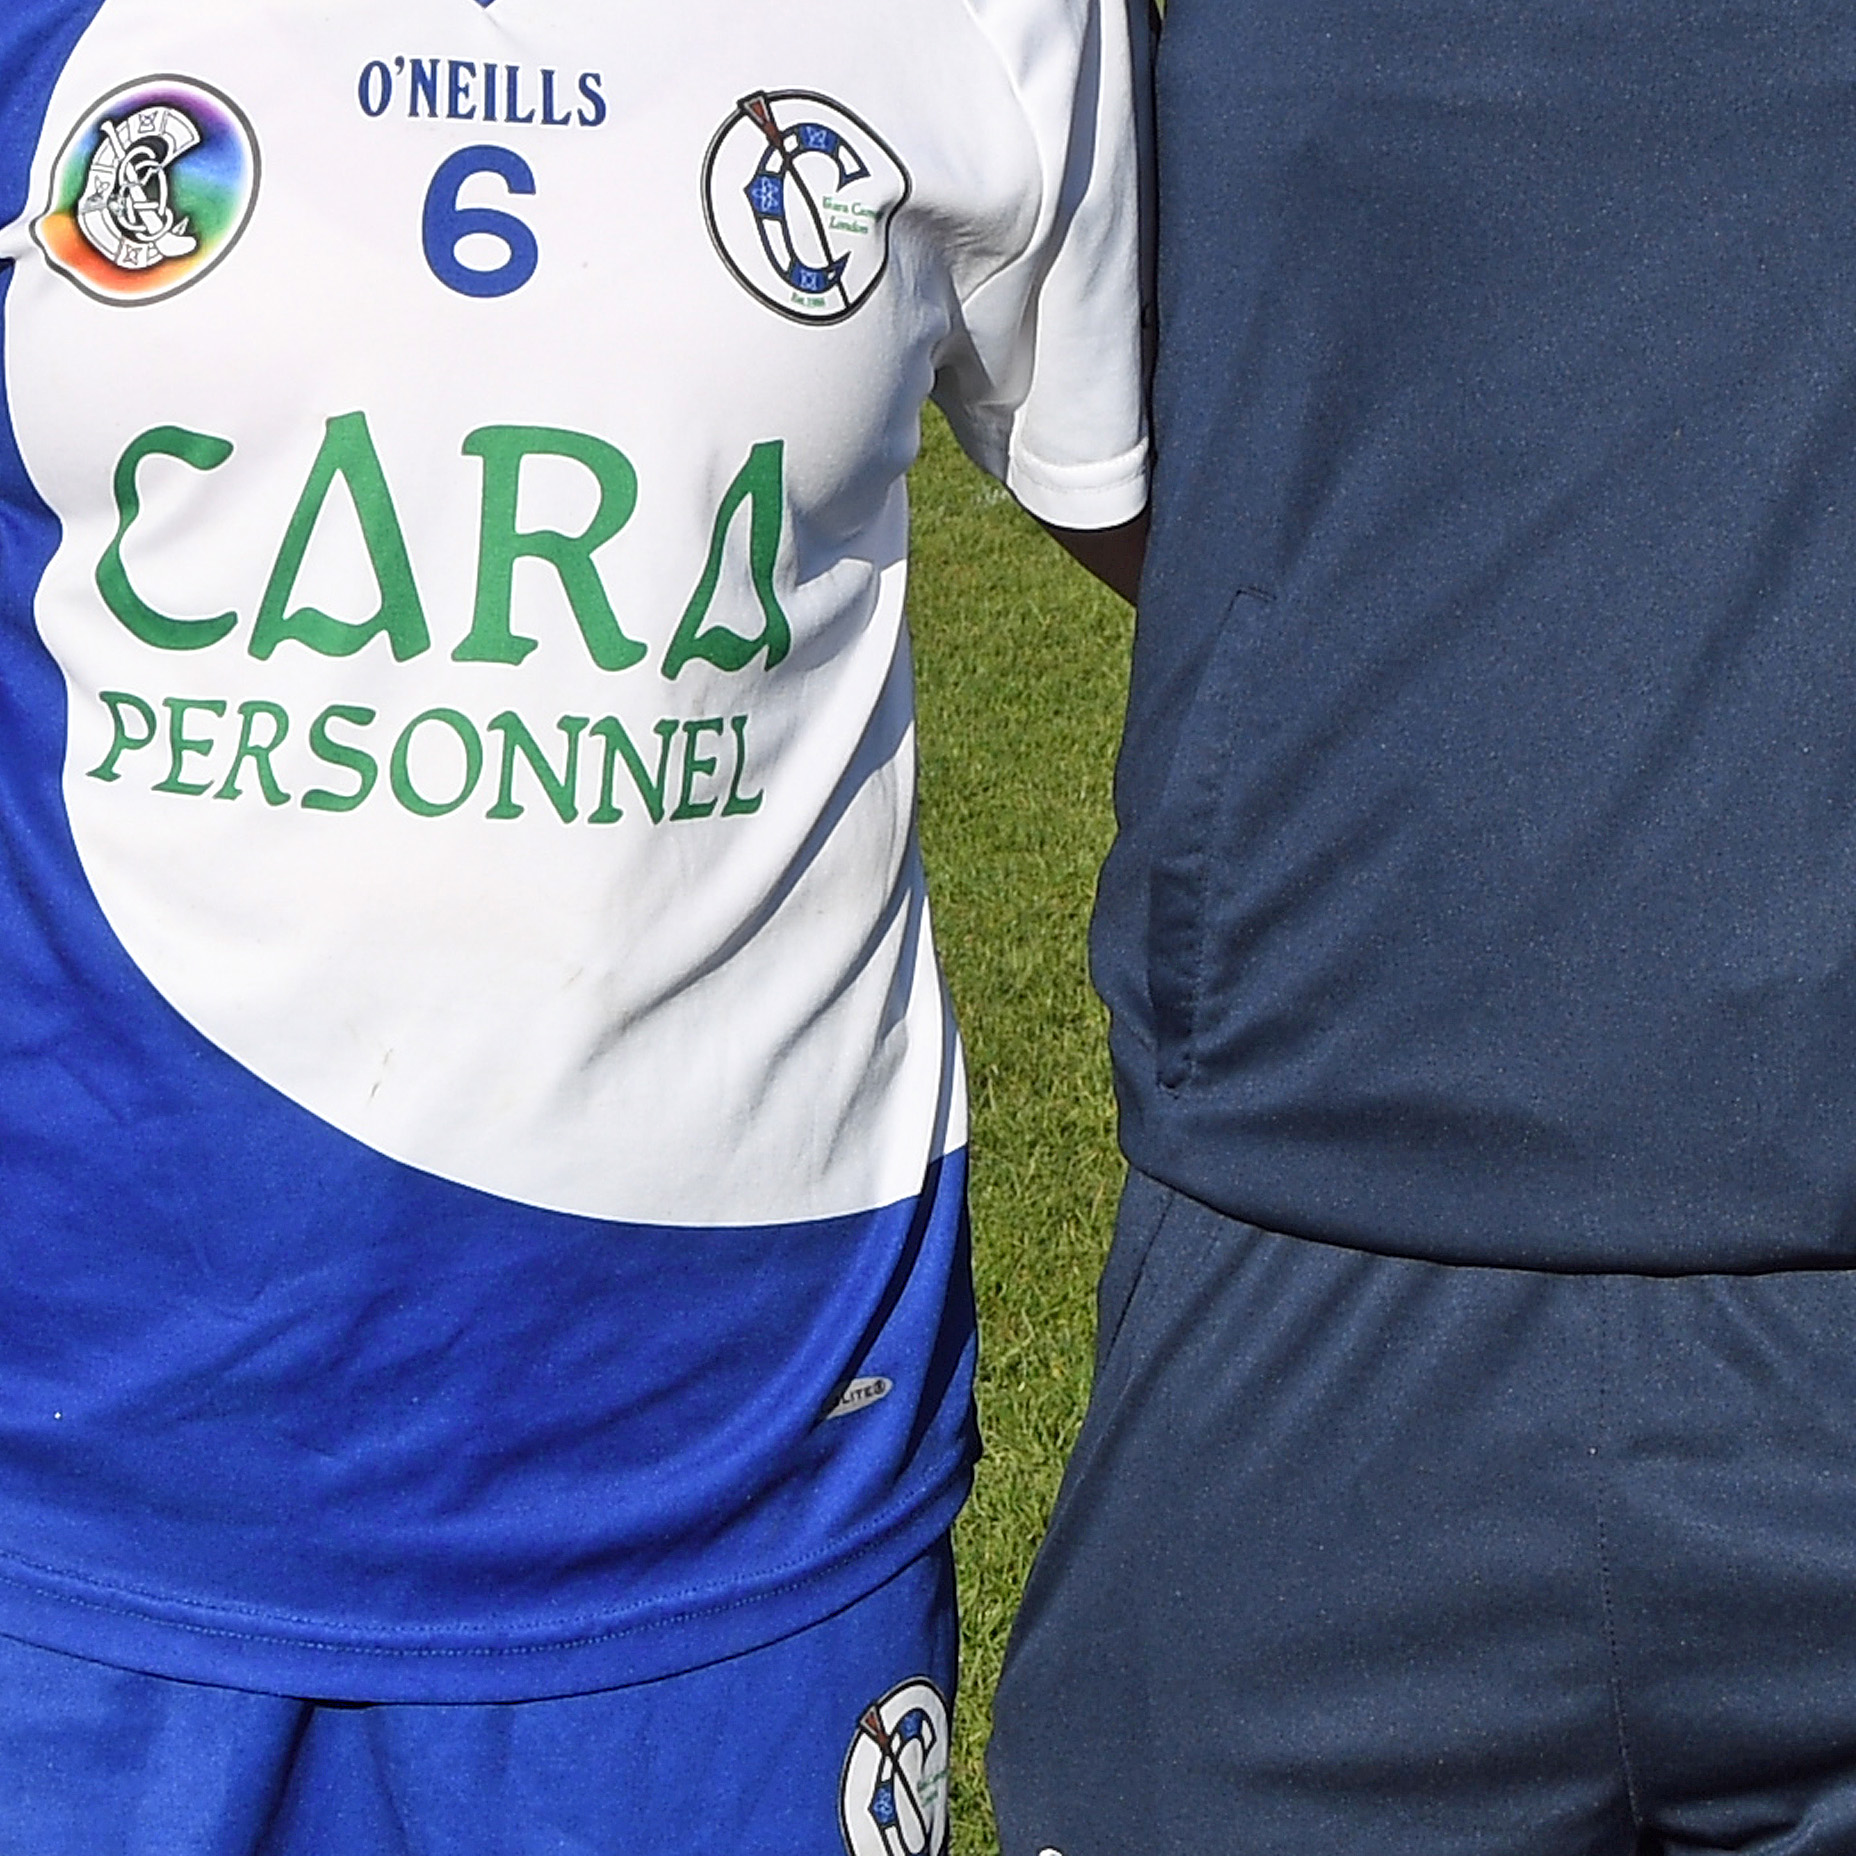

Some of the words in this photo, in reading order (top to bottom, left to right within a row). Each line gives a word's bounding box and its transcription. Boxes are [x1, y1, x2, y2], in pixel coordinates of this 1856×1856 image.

[359, 57, 608, 127] O'NEILLS
[422, 145, 539, 298] 6
[96, 411, 791, 681] CARA
[87, 690, 764, 825] PERSONNEL
